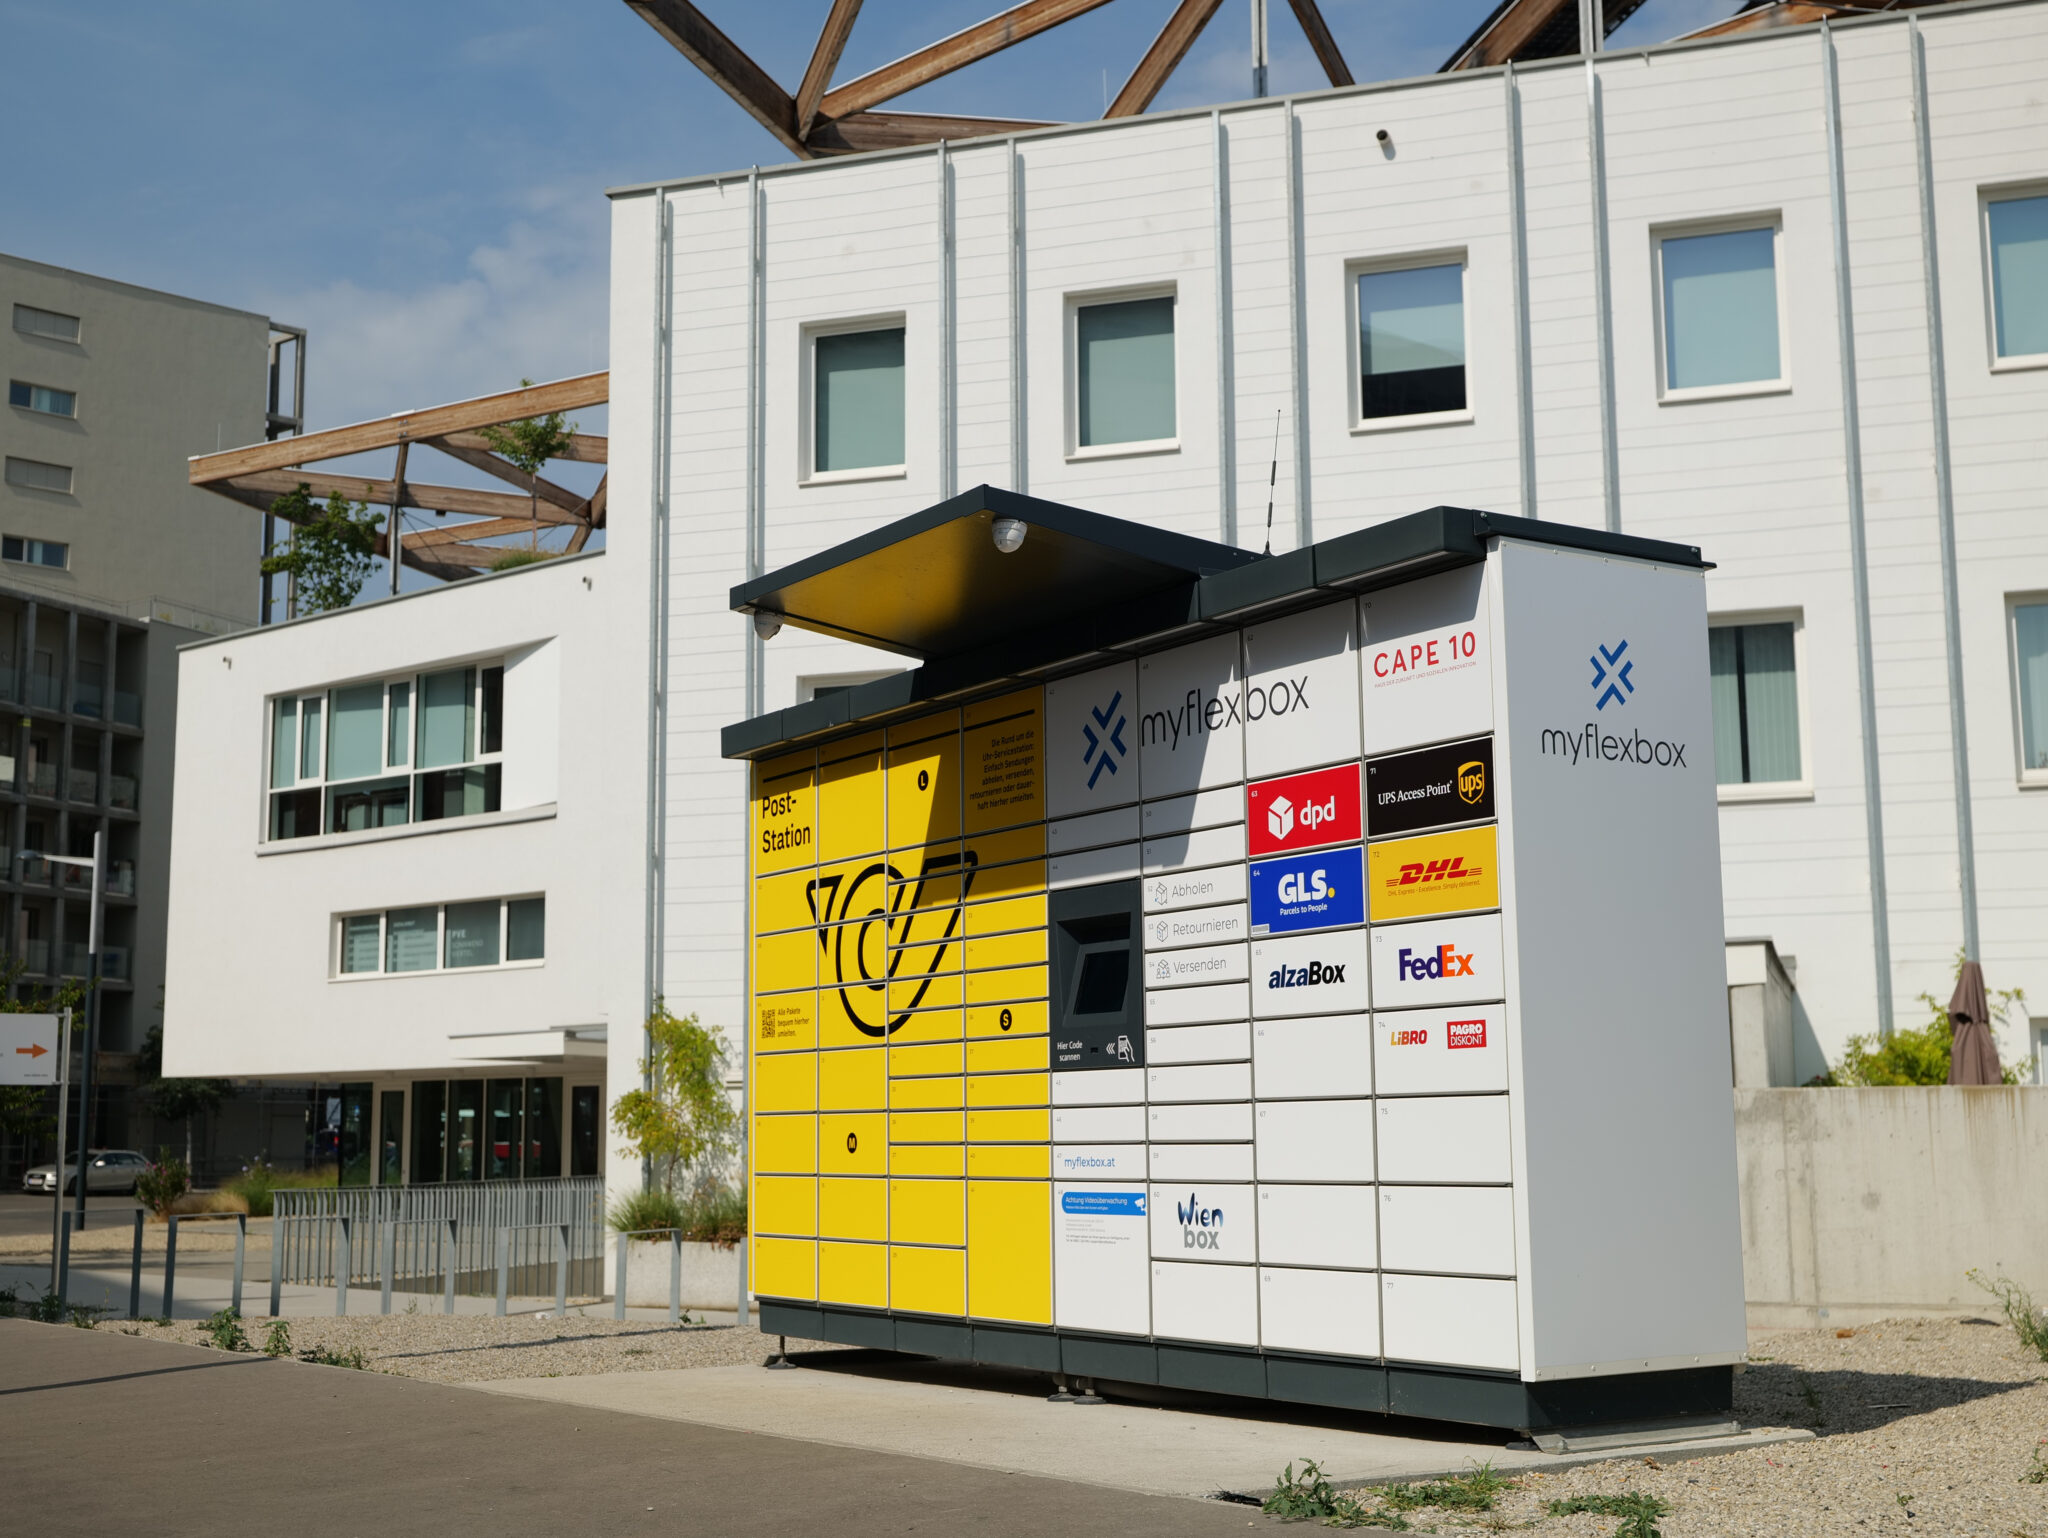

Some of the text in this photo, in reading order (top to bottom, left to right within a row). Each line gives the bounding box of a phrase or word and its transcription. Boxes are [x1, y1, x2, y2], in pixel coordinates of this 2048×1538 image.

[1373, 631, 1476, 678] CAPE 10
[1141, 675, 1310, 752] myflexbox
[1541, 723, 1688, 768] myflexbox
[1378, 791, 1397, 805] UPS
[1397, 788, 1425, 802] Access
[1460, 773, 1483, 798] ups
[762, 791, 797, 819] Post-
[1300, 795, 1336, 830] dpd
[762, 823, 811, 853] Station
[1399, 856, 1469, 885] DHL
[1172, 882, 1214, 898] Abholen
[1279, 902, 1328, 916] Parcels to People
[1173, 918, 1239, 937] Retournieren
[1173, 957, 1227, 974] Versenden
[1268, 960, 1346, 990] alzaBox
[1399, 944, 1475, 981] FedEx
[1450, 1023, 1483, 1035] PAGRO
[1450, 1034, 1483, 1046] DISKONT
[1057, 1040, 1083, 1051] Hier Code
[1059, 1053, 1081, 1062] scannen
[1063, 1156, 1116, 1170] myflexbox.at
[1177, 1192, 1224, 1228] Wien
[1183, 1223, 1220, 1250] box
